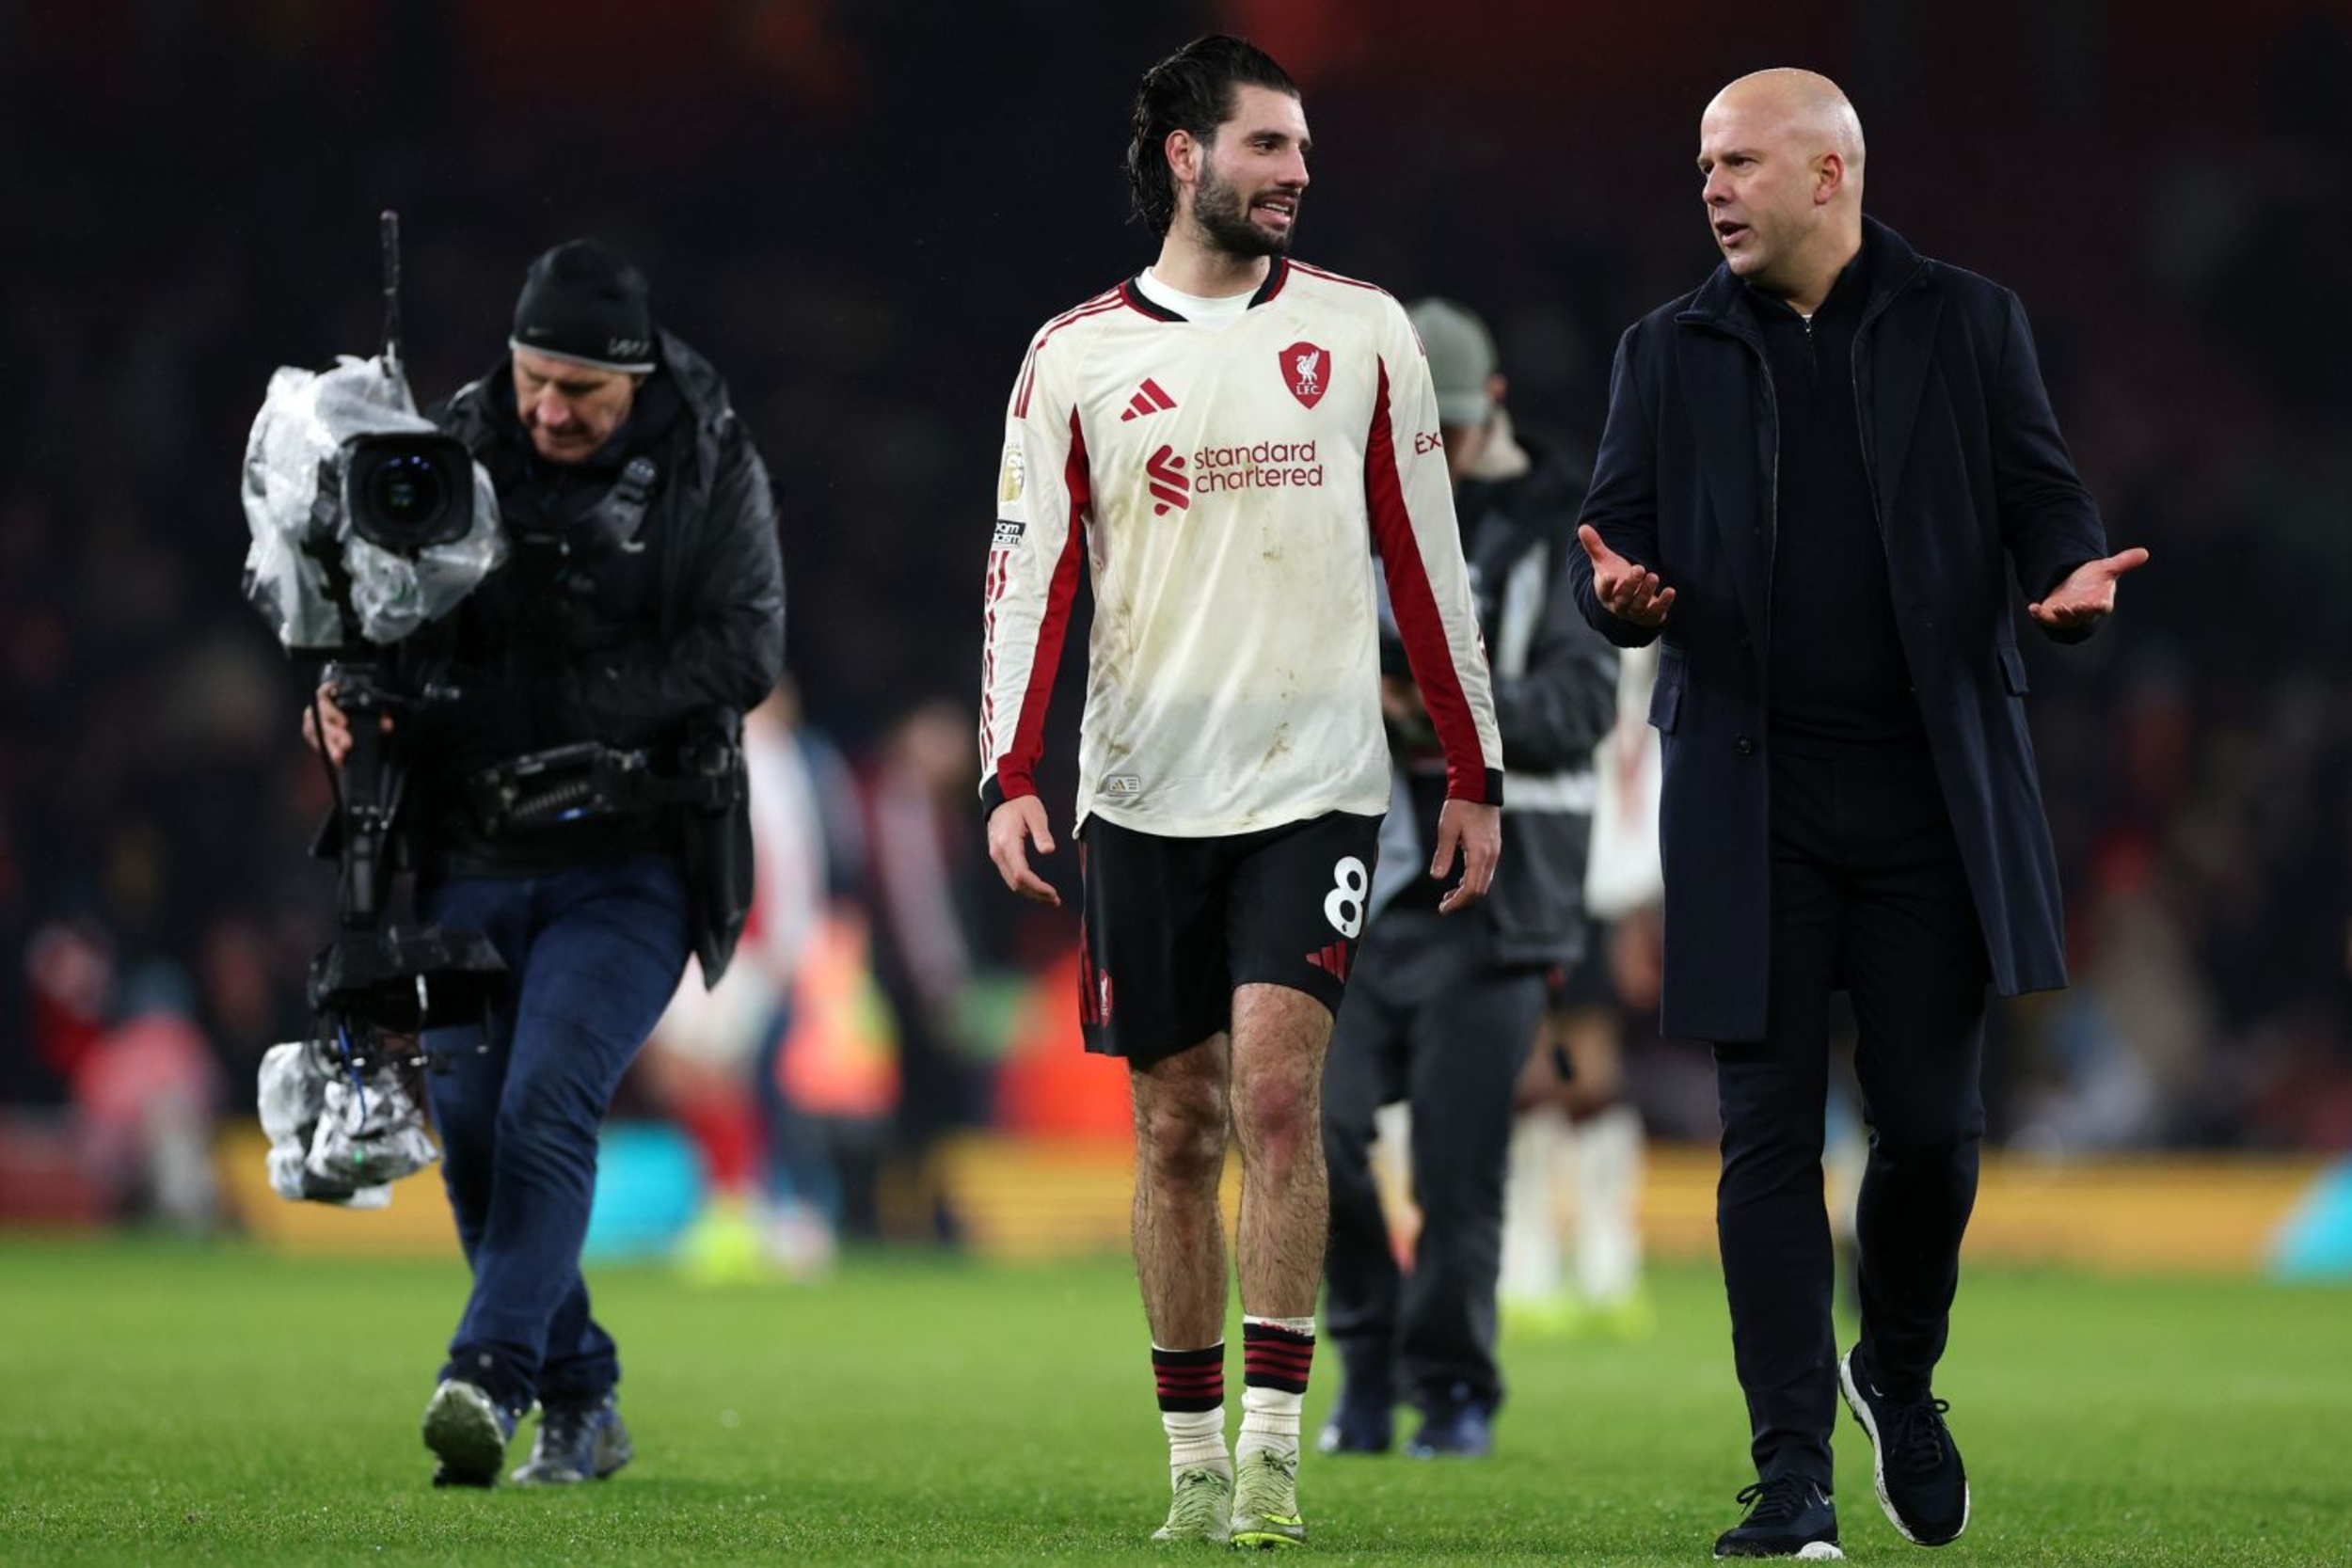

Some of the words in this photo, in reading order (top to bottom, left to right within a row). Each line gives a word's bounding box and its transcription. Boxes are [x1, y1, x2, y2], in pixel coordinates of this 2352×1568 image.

[1296, 385, 1322, 395] LFC
[1194, 440, 1315, 469] standard
[1195, 465, 1323, 493] chartered
[1324, 856, 1368, 939] 8
